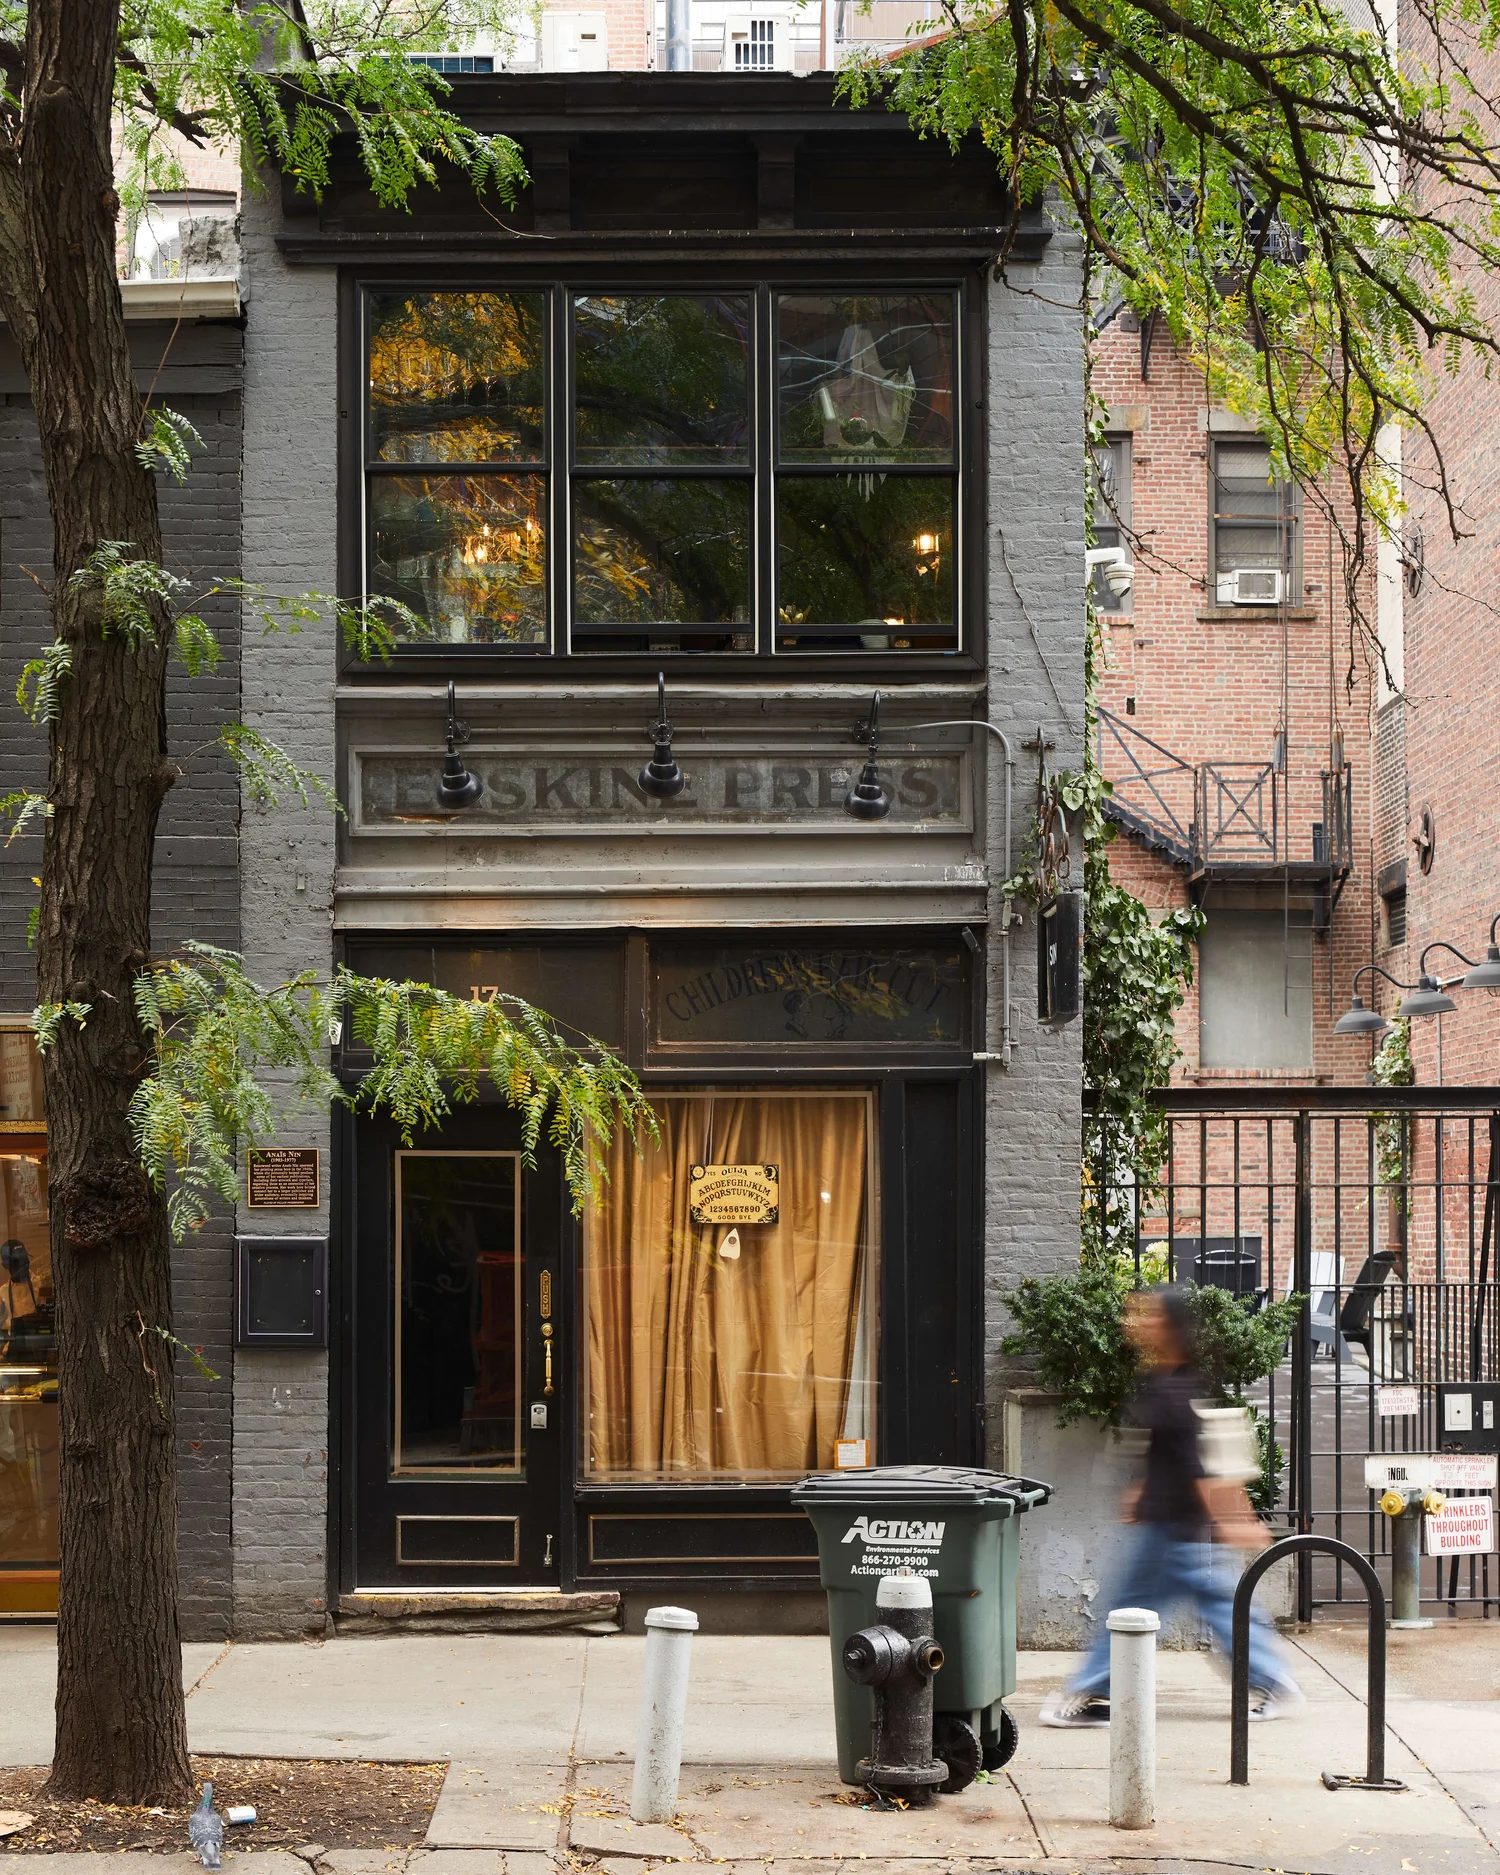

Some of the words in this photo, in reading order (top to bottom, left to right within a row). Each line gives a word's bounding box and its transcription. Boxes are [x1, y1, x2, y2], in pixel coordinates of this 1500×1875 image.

[394, 767, 698, 809] ESKIN
[470, 986, 499, 1004] 17
[722, 1167, 748, 1176] OUIJA
[698, 1179, 770, 1197] ABCDEFGHIJKLM
[699, 1188, 770, 1208] NOPQRSTUVWXYZ
[1433, 1504, 1486, 1518] RINKLERS
[841, 1516, 946, 1546] ACTION
[1431, 1519, 1488, 1533] THROUGHOUT
[1441, 1534, 1480, 1548] BUILDING
[862, 1555, 928, 1566] 866-270-9900
[851, 1565, 939, 1577] Actioncartg.com
